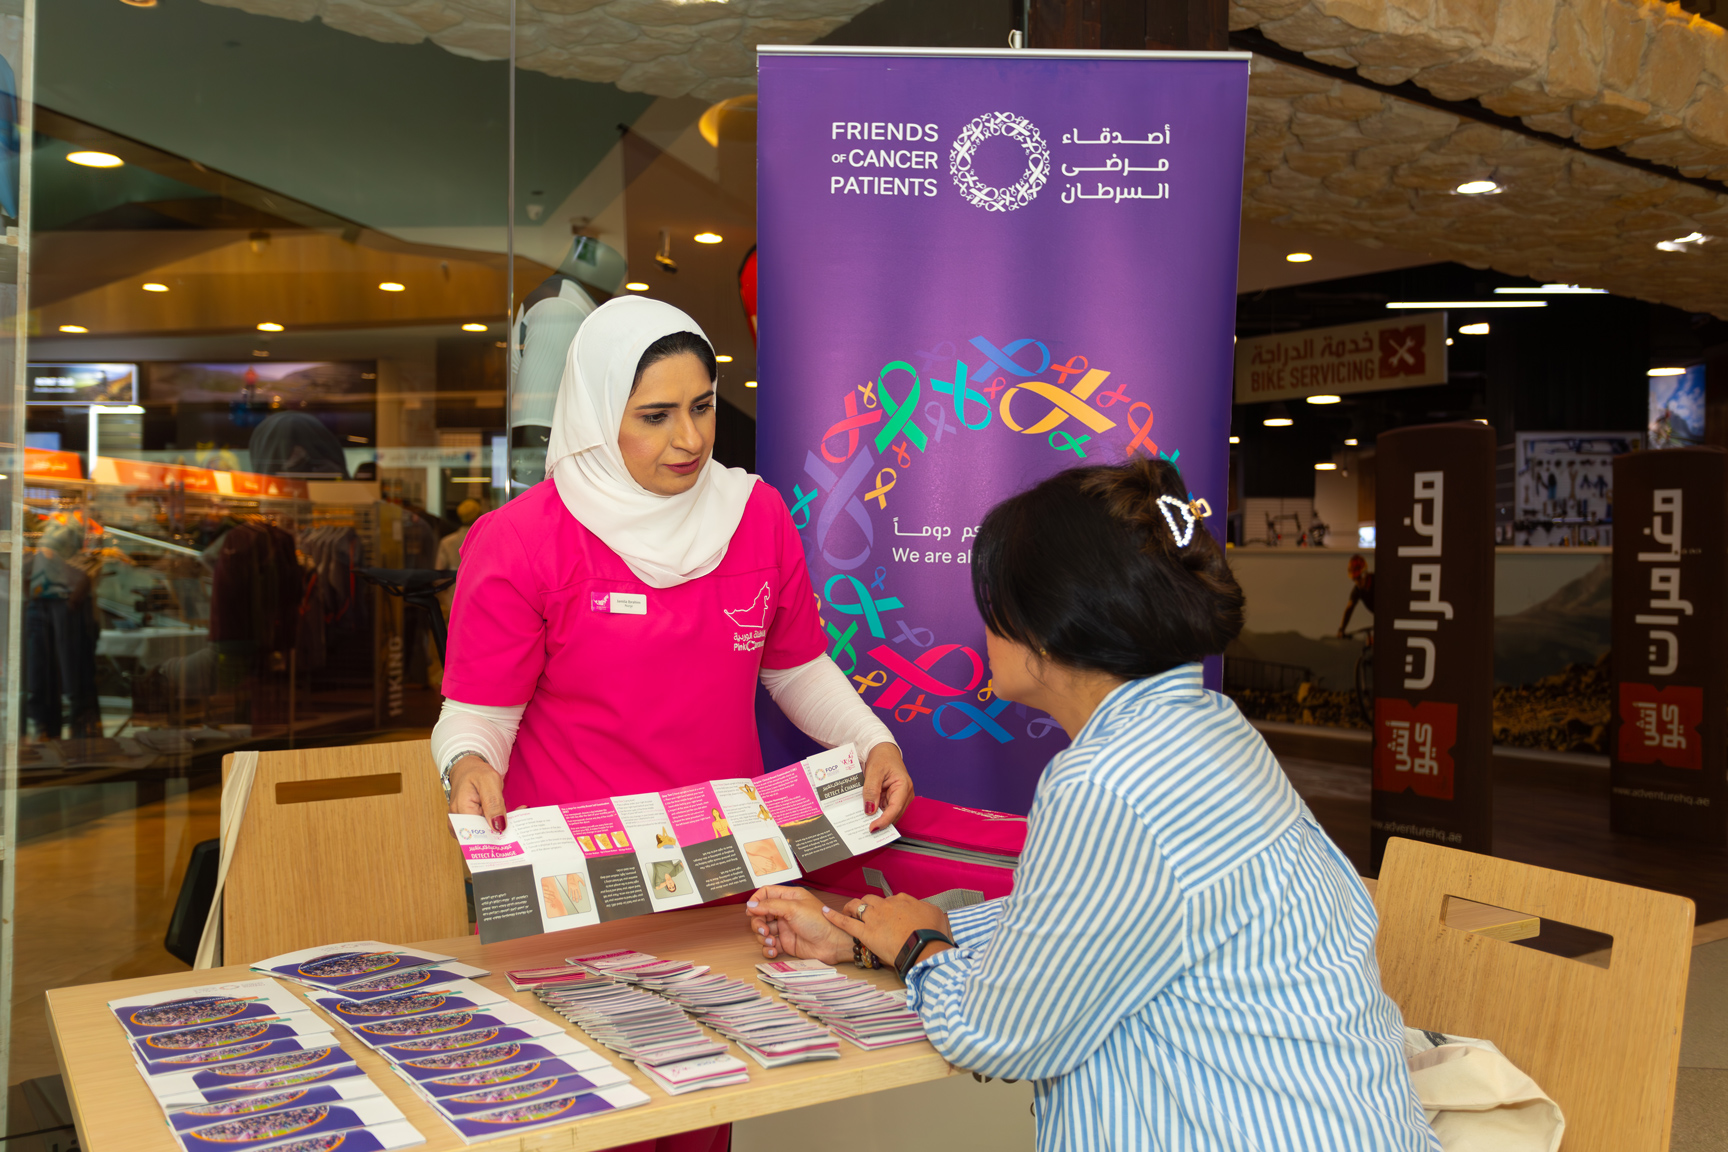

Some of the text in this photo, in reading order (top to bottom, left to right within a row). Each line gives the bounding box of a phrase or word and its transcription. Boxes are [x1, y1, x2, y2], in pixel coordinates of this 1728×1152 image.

[832, 122, 939, 143] FRIENDS
[1061, 123, 1171, 145] أصدقاء
[832, 149, 938, 169] OF CANCER
[1061, 154, 1170, 176] مرضى
[830, 176, 938, 197] PATIENTS
[1060, 182, 1170, 204] السرطان
[1251, 331, 1374, 370] خدمة الدراجة
[1251, 359, 1375, 392] BIKE SERVICING
[892, 547, 971, 564] We are al
[388, 636, 403, 717] HIKING
[824, 788, 840, 798] DETECT
[844, 782, 861, 790] CHANGE
